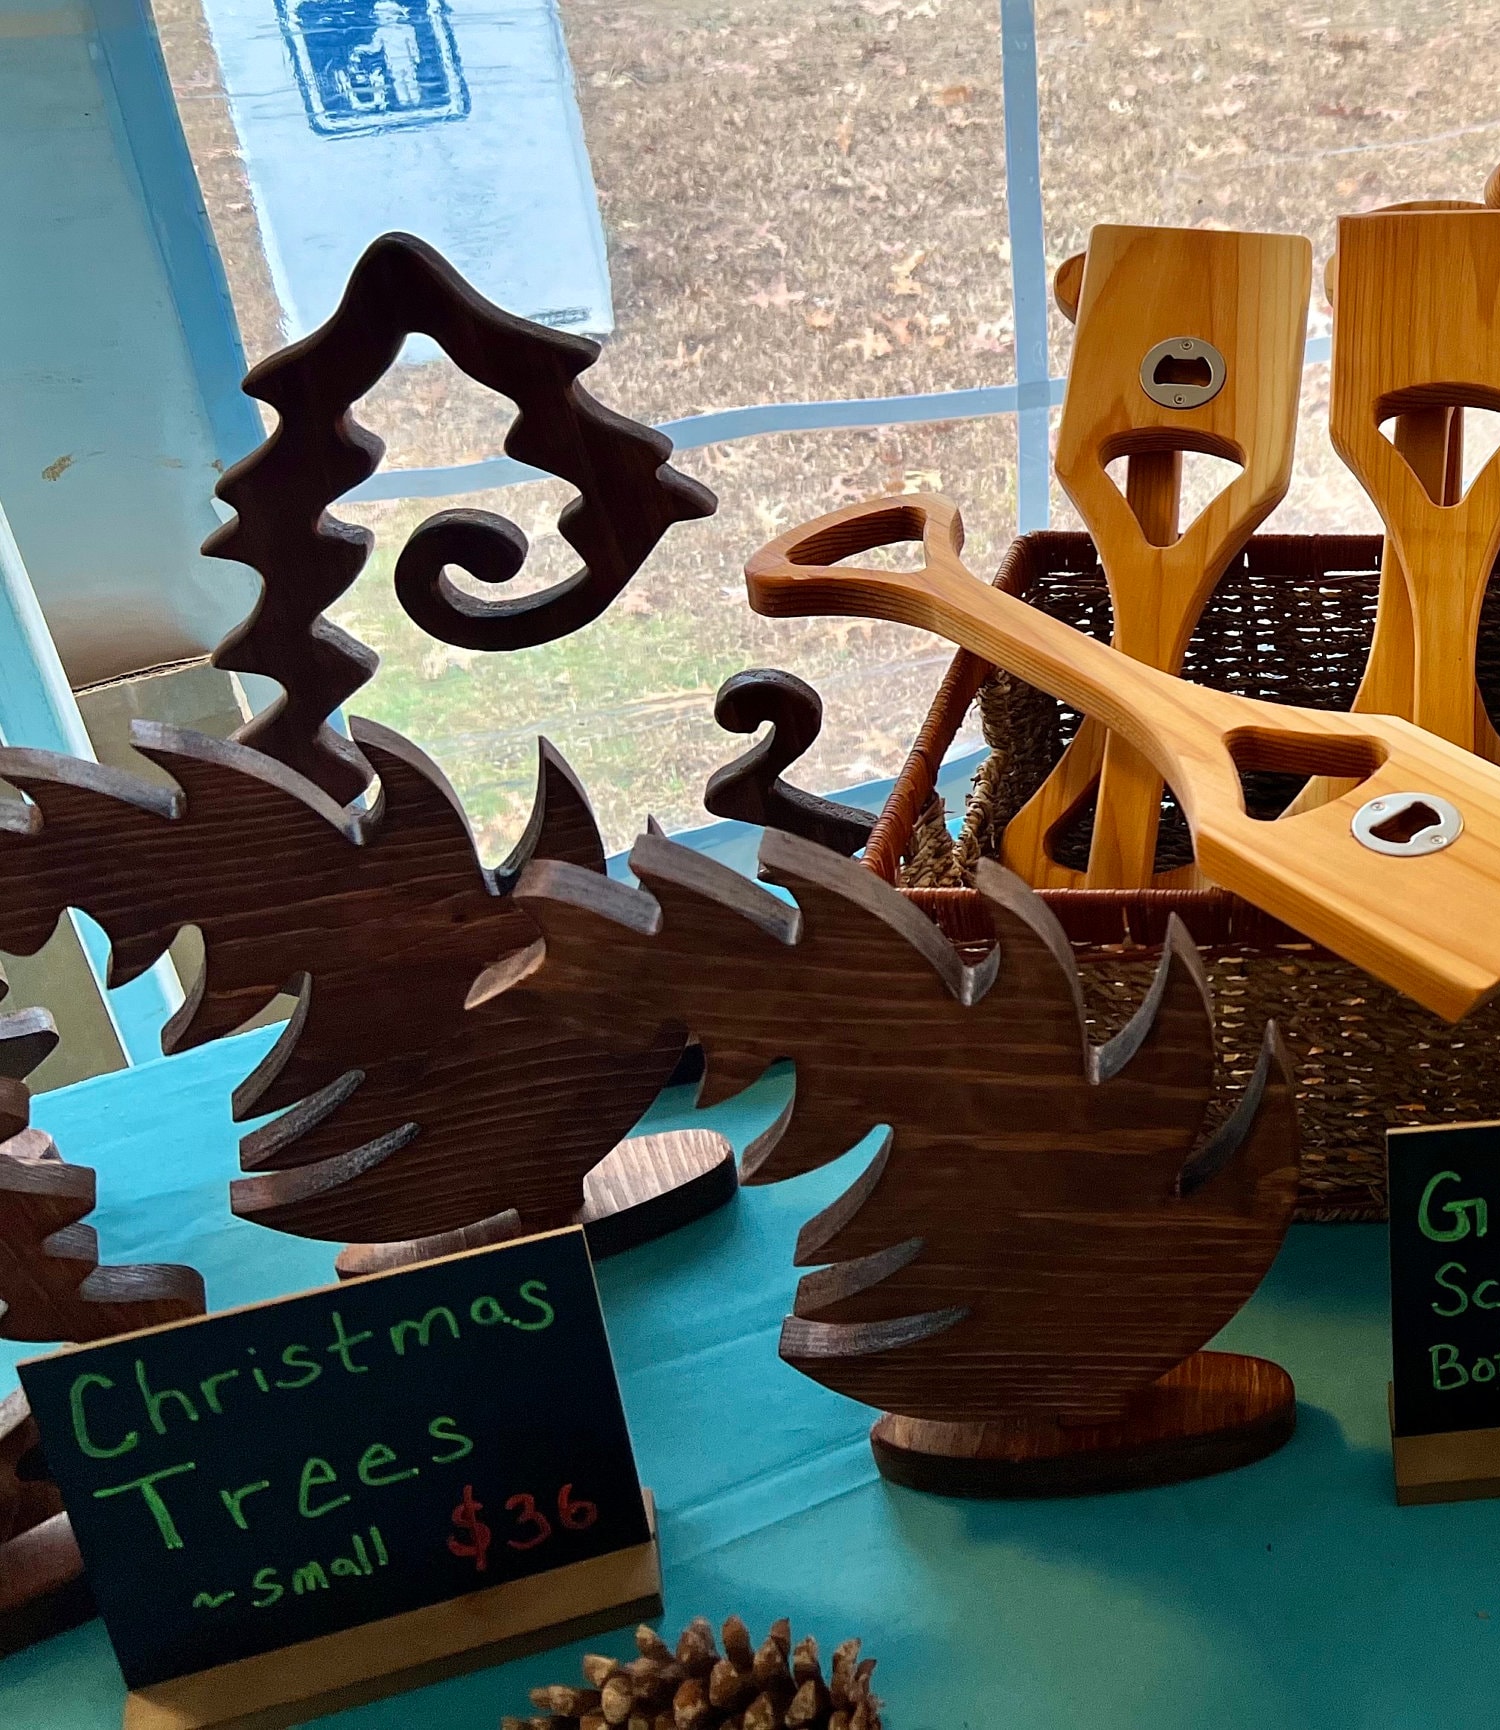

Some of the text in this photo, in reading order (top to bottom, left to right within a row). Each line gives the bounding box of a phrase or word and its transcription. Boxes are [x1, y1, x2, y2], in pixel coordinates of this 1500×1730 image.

[70, 1280, 555, 1459] Christmas
[93, 1416, 474, 1550] Trees
[446, 1483, 598, 1571] $36
[251, 1525, 390, 1608] small
